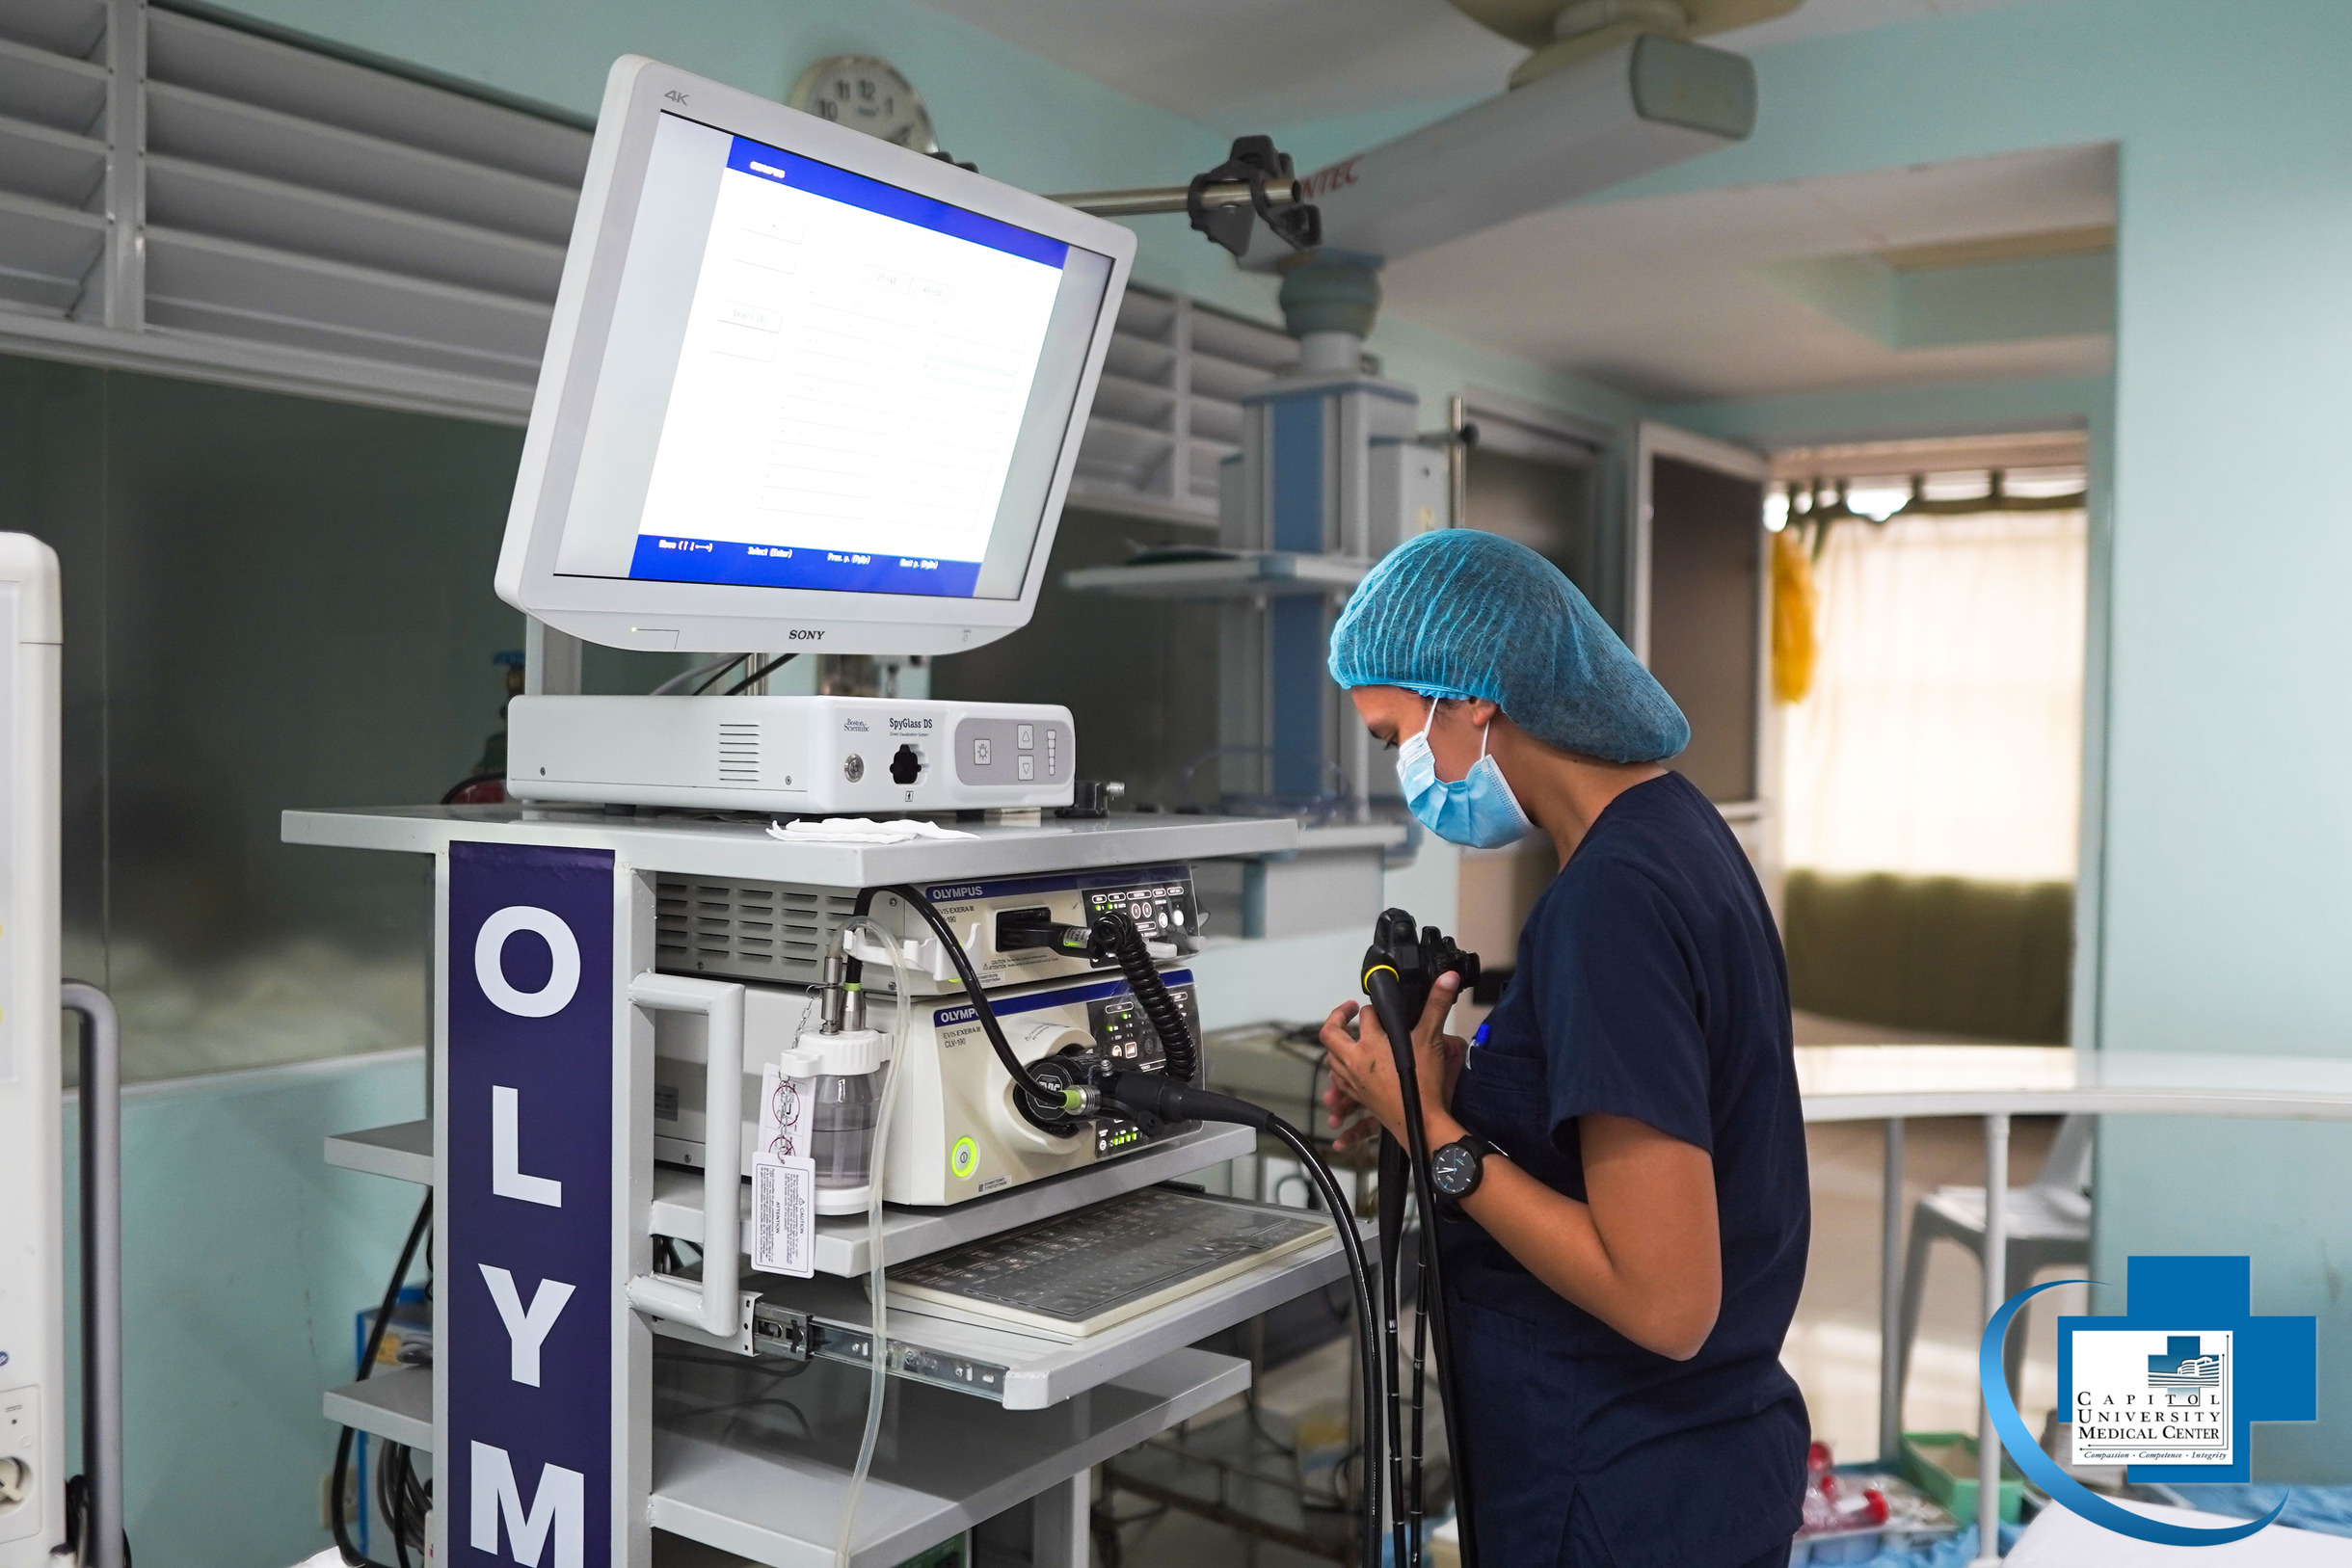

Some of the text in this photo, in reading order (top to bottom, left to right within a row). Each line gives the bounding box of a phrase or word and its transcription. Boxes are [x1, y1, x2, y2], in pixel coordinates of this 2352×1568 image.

[664, 90, 690, 106] 4K
[788, 629, 825, 640] SONY
[843, 723, 869, 732] Scientific
[889, 717, 933, 731] SpyGlass DS
[932, 886, 983, 900] OLYMPUS
[949, 906, 970, 915] EXERA
[940, 1007, 979, 1023] OLYMP
[943, 1030, 956, 1040] EVIS
[956, 1027, 976, 1037] EXERA
[944, 1037, 967, 1049] CLV-190
